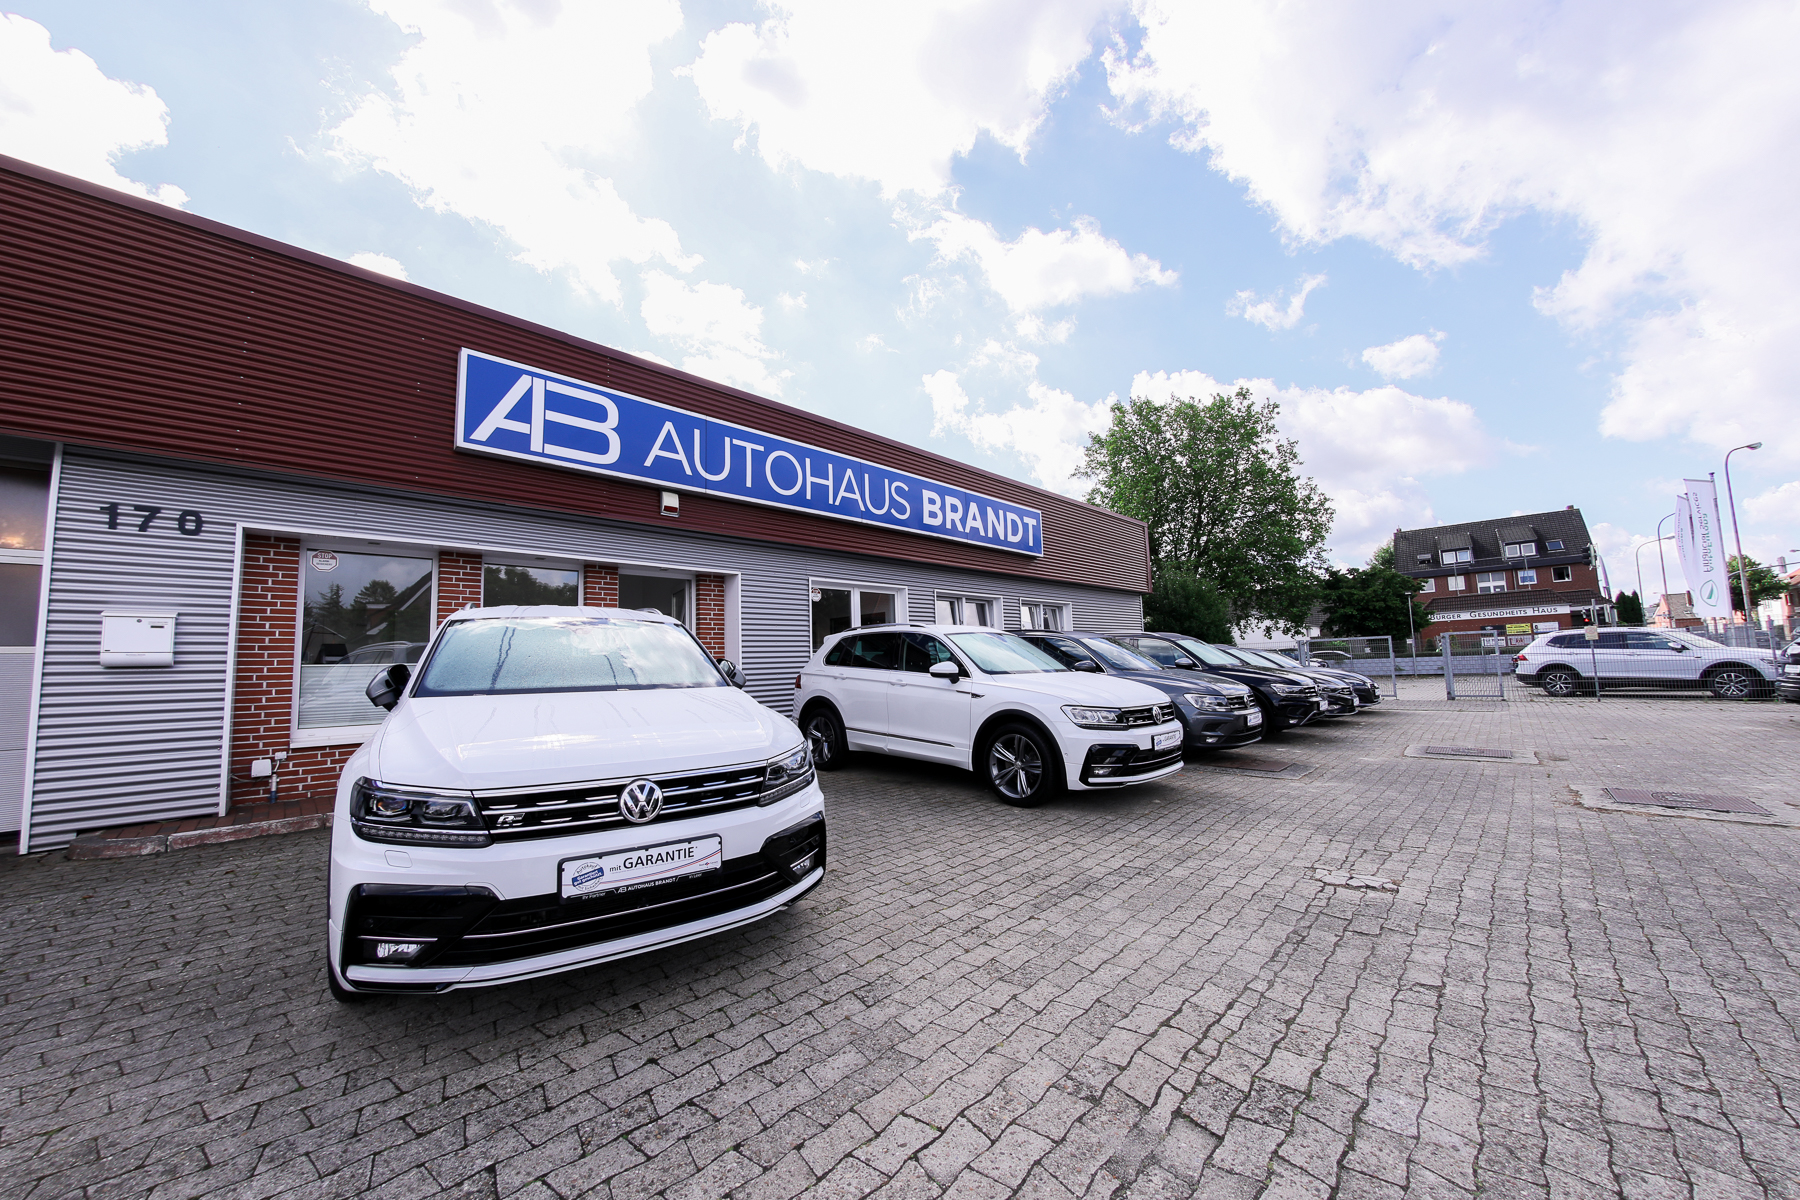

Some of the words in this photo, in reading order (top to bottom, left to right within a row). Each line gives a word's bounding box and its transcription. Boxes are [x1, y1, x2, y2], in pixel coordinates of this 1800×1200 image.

[643, 420, 911, 520] AUTOHAUS
[922, 489, 1037, 547] BRANDT
[100, 503, 203, 536] 170
[1469, 609, 1528, 618] GESUNDHEITS
[609, 864, 622, 873] mit
[623, 846, 695, 870] GARANTIE
[628, 881, 655, 891] AUTOHAUS
[655, 877, 676, 886] BRANDT
